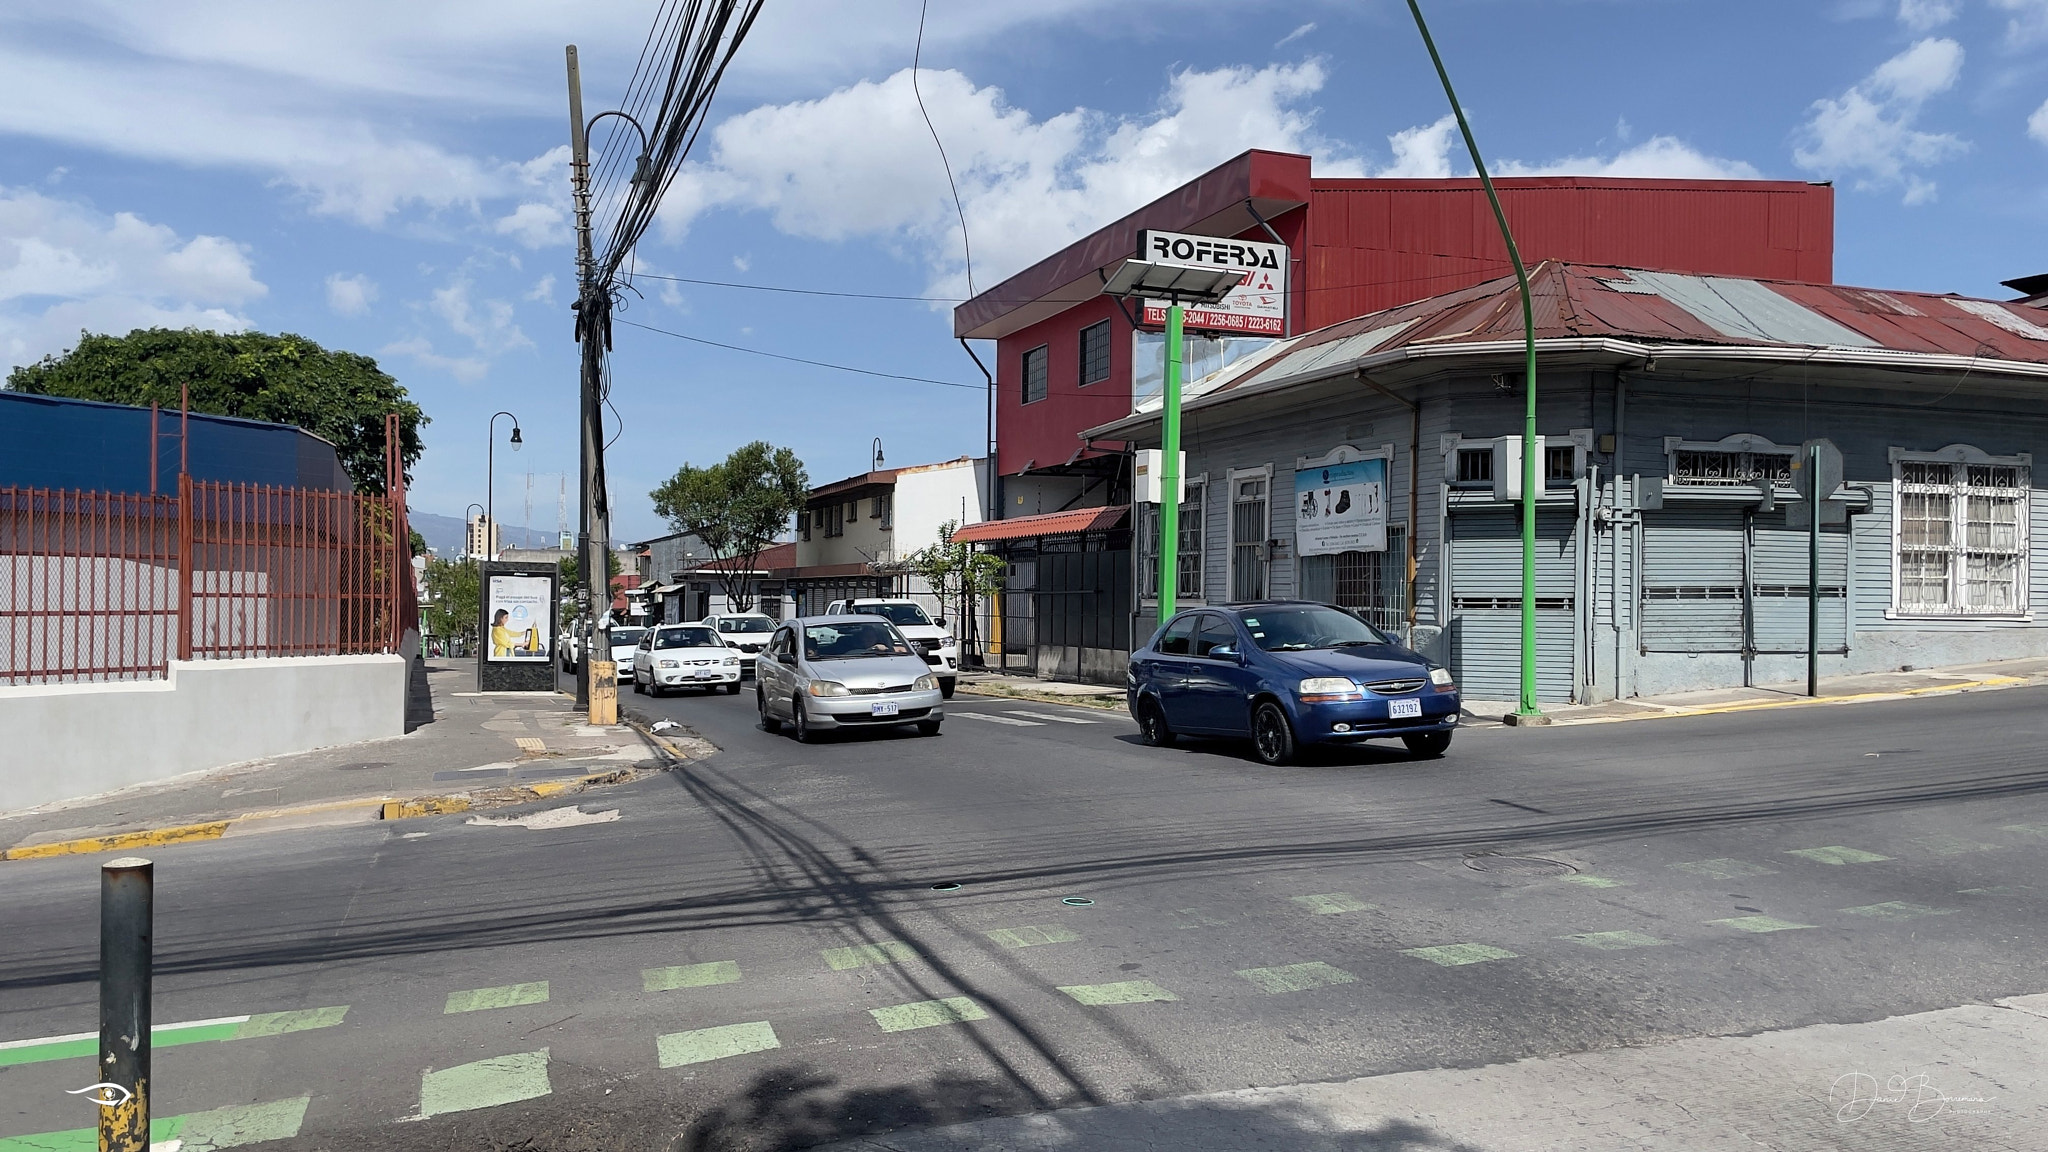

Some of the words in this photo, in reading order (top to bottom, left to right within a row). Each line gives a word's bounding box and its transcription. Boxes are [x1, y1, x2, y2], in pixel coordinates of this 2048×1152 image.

[1153, 236, 1279, 270] ROFERSA
[1200, 302, 1231, 311] MITSUBISHI
[1210, 313, 1244, 328] 2256-0685
[1248, 317, 1281, 331] 2223-6162
[1392, 703, 1418, 714] 632192
